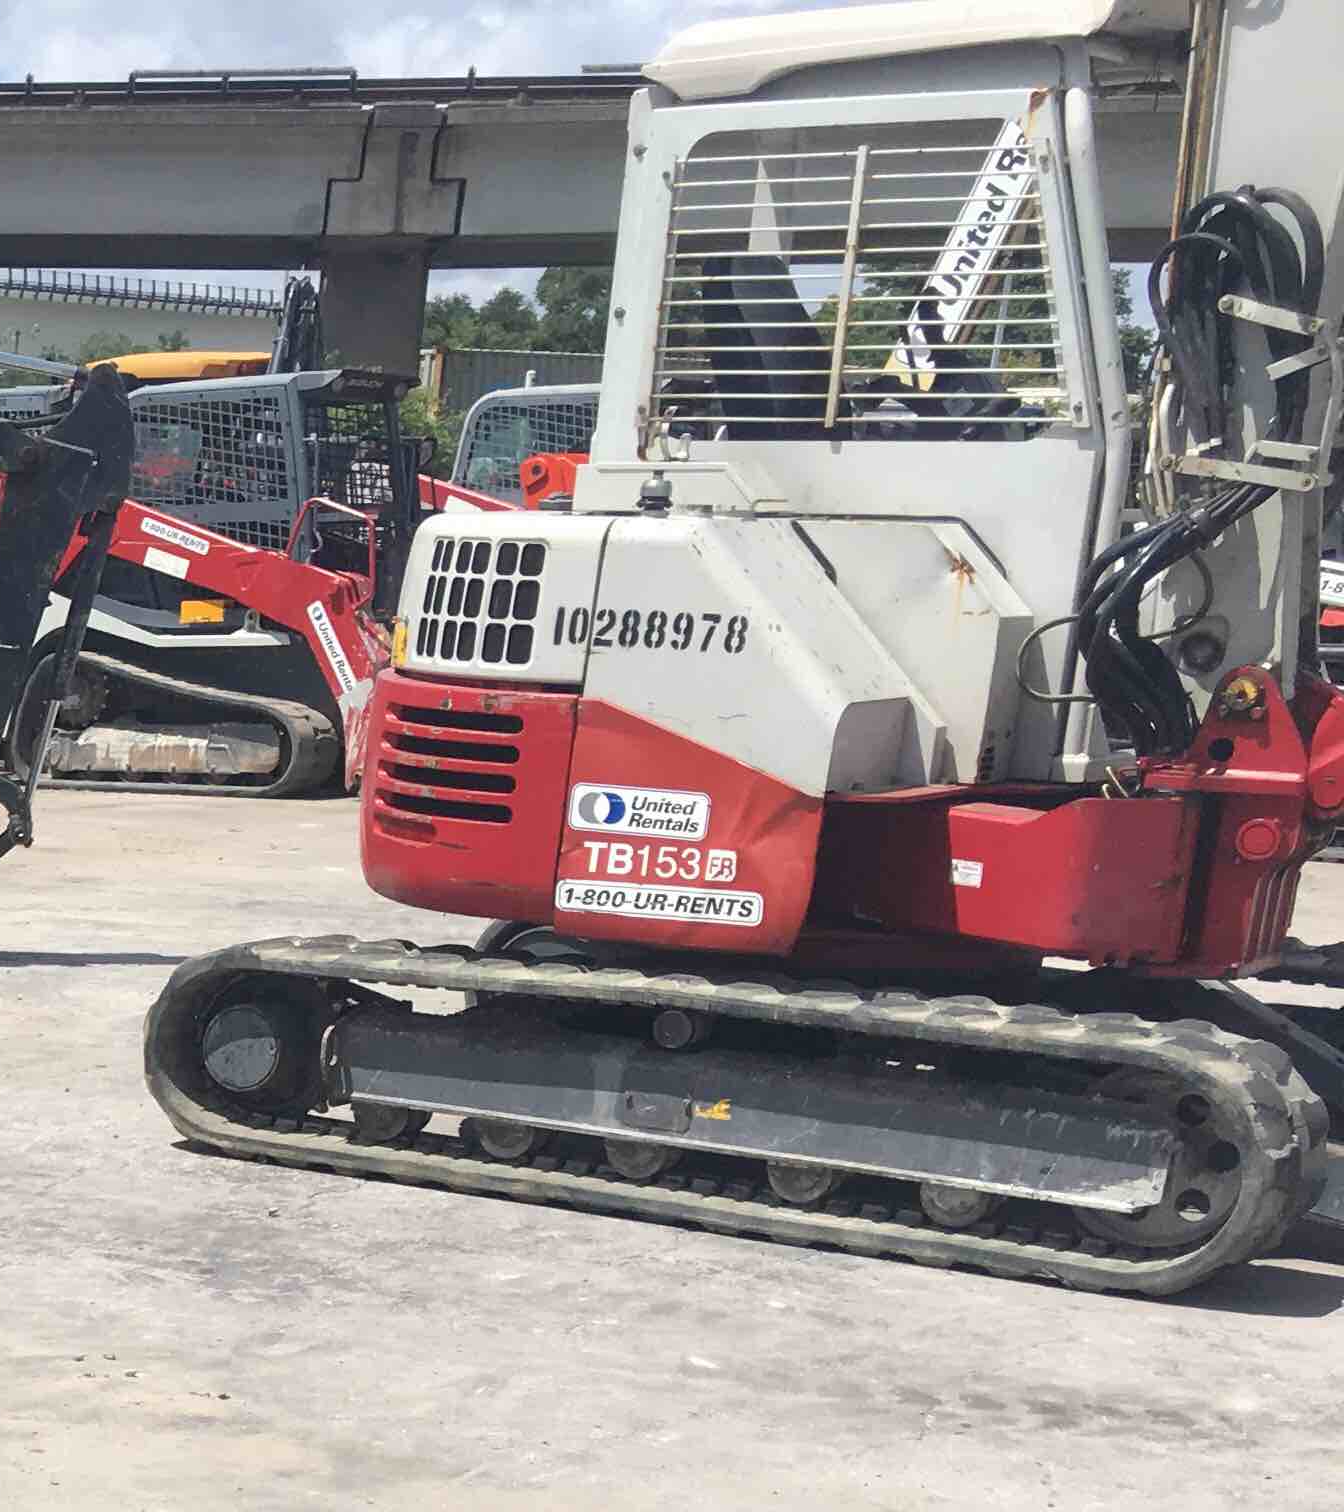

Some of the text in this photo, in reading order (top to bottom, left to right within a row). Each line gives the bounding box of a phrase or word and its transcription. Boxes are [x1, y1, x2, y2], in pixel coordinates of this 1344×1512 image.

[317, 621, 339, 661] United
[552, 606, 750, 655] 10288978
[627, 812, 700, 834] Rentals
[631, 796, 697, 816] United
[583, 841, 703, 881] TB153
[564, 887, 755, 919] 1-800-UR-RENTS
